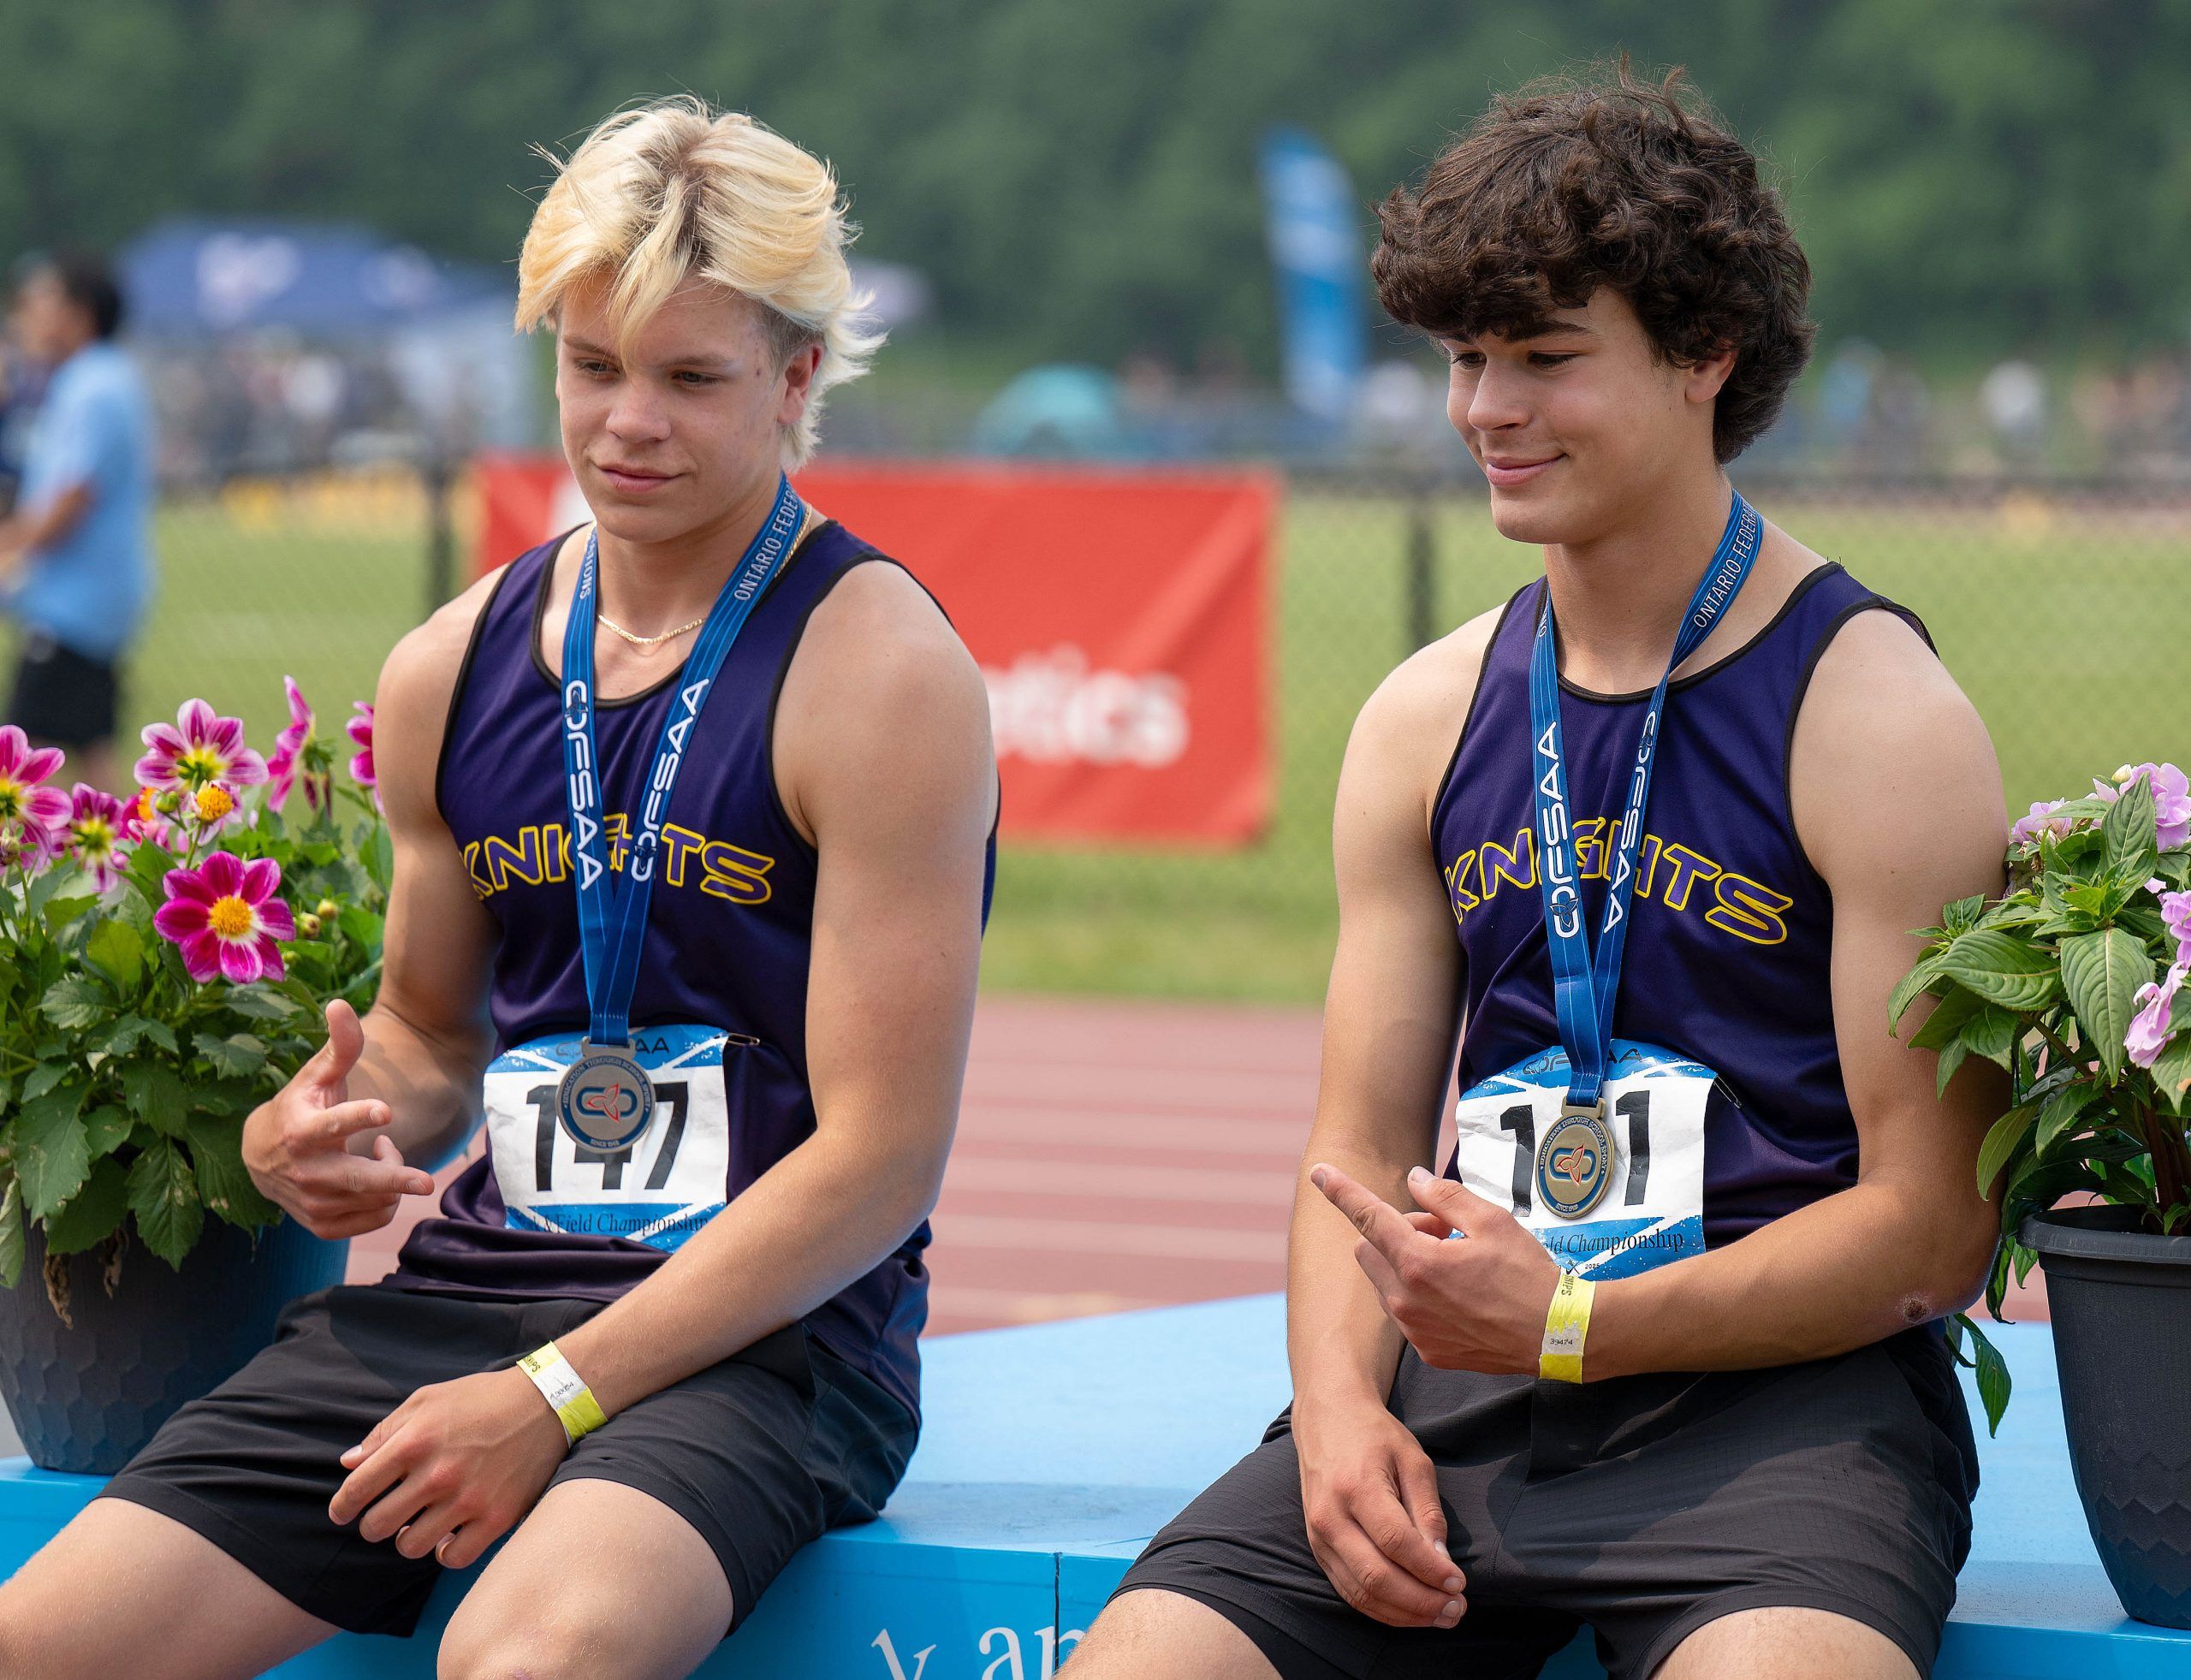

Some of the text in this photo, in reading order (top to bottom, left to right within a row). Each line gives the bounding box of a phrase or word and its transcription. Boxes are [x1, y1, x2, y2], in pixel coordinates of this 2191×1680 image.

[734, 537, 781, 600] ONTARIO
[1694, 559, 1741, 628] ONTARIO
[1445, 816, 1793, 945] KNGHTS
[556, 1037, 669, 1055] OAA
[1523, 1048, 1642, 1074] OFA
[1500, 1089, 1650, 1217] 11
[555, 1213, 592, 1232] Field
[1567, 1228, 1684, 1256] Championship
